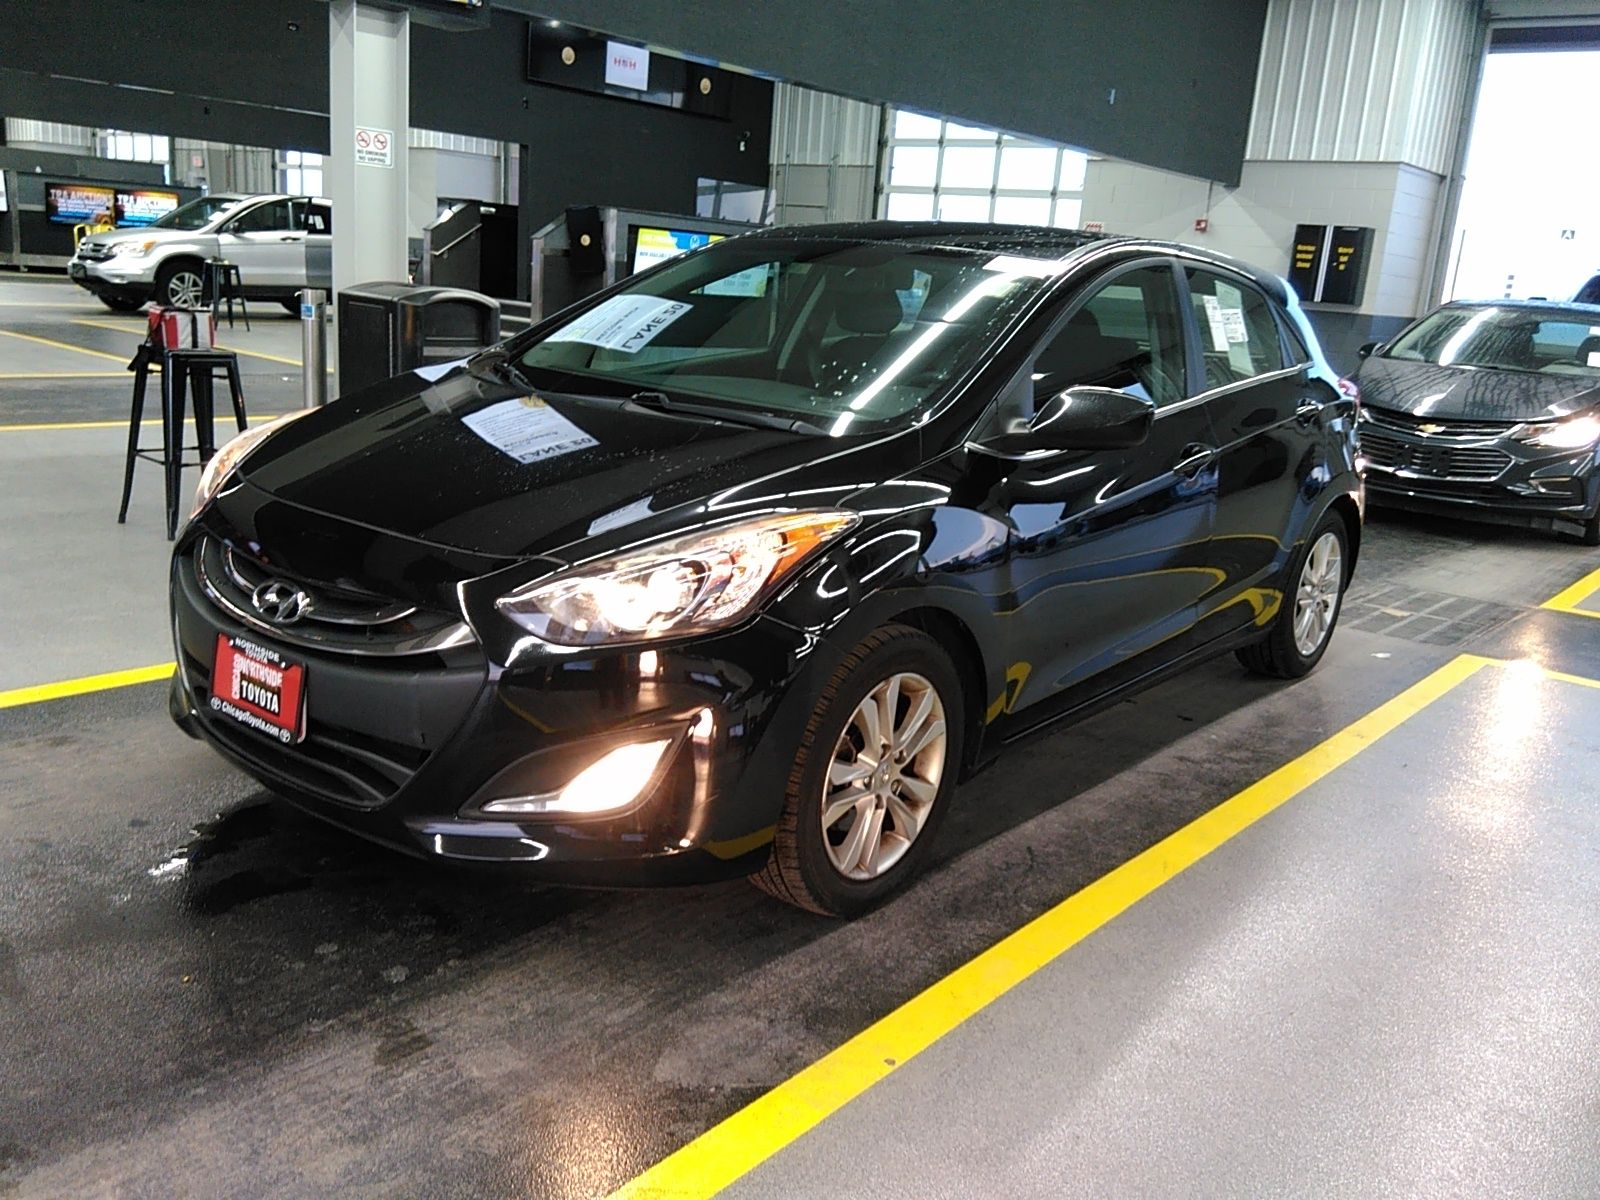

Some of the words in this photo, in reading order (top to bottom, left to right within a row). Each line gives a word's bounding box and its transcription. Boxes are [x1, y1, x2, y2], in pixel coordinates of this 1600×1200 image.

[235, 637, 280, 662] NORTHSIDE
[239, 657, 283, 688] NORTHSIDE
[241, 680, 279, 713] TOYOTA
[221, 700, 280, 737] ChicagoToyota.com
